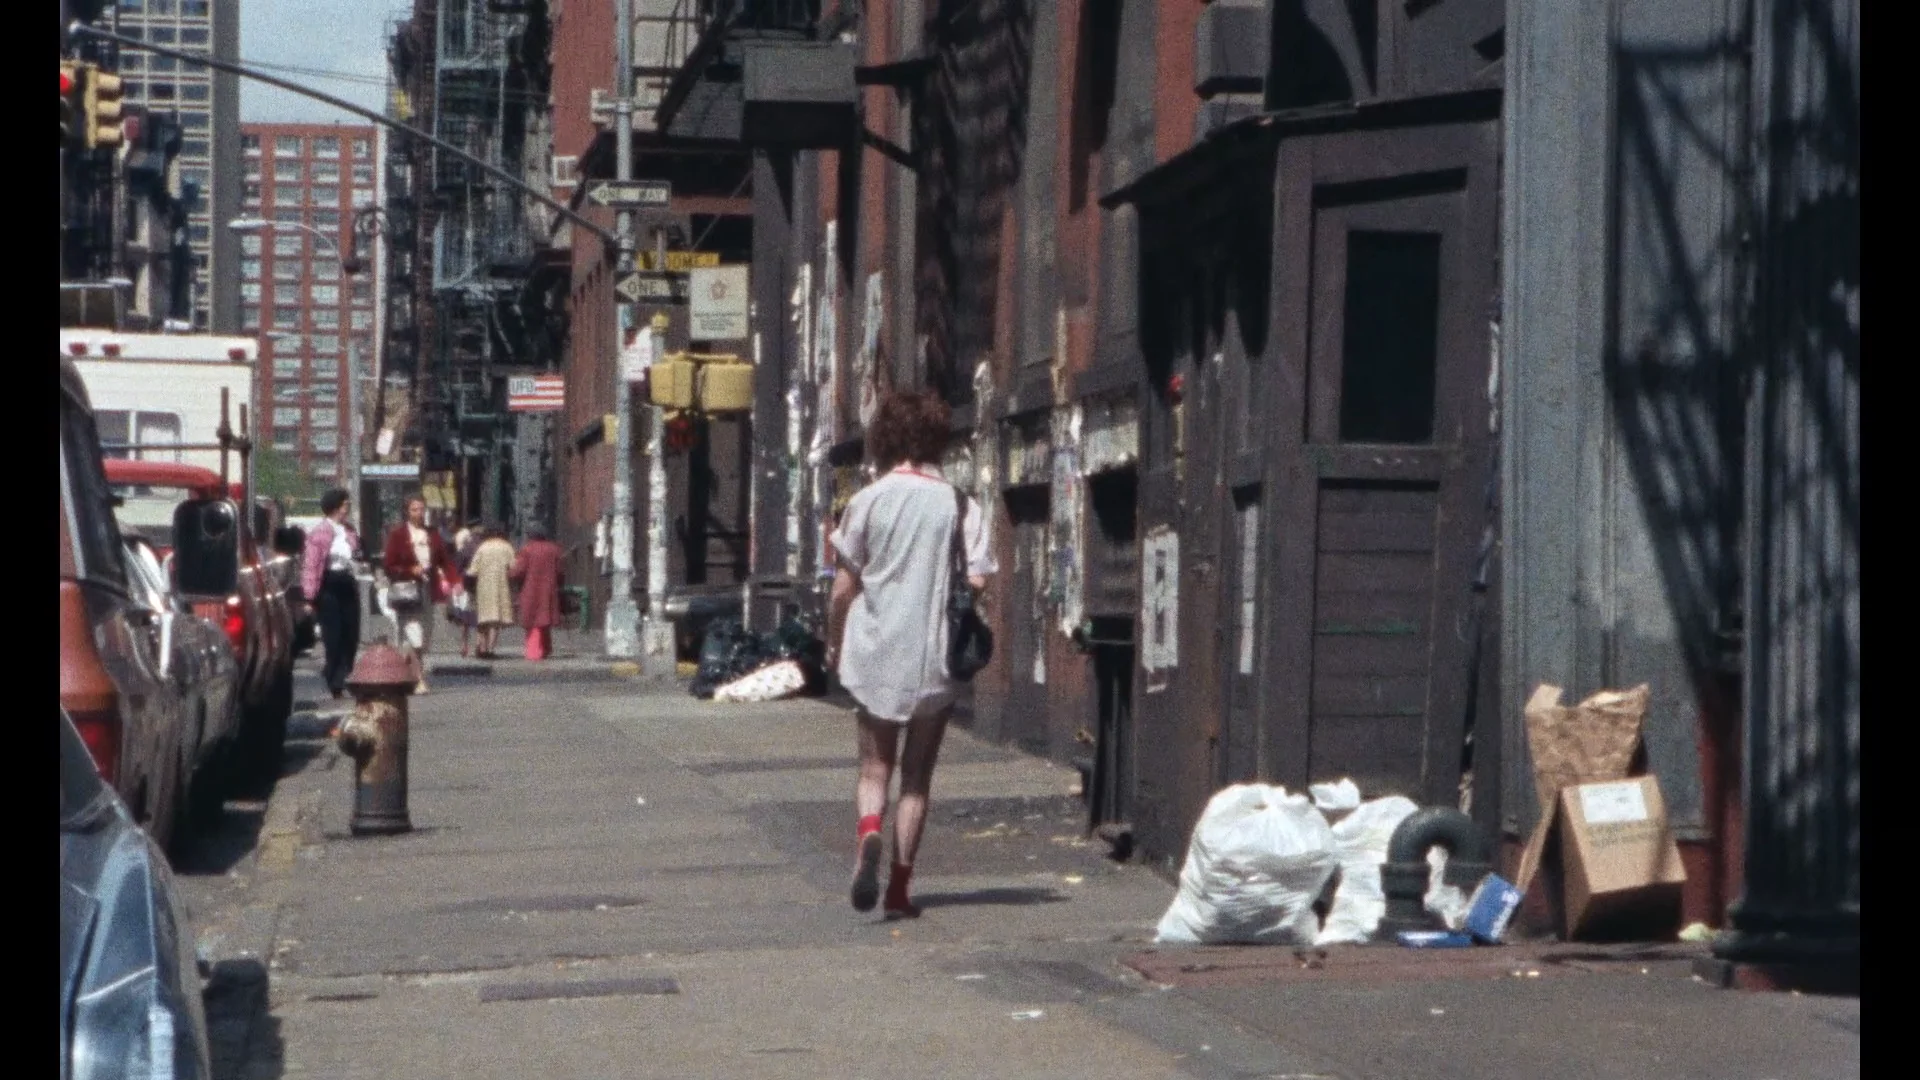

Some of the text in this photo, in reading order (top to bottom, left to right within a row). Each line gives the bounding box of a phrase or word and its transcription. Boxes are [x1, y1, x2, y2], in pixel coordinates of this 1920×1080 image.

[598, 187, 664, 200] ONE WAY
[627, 281, 659, 295] ONE
